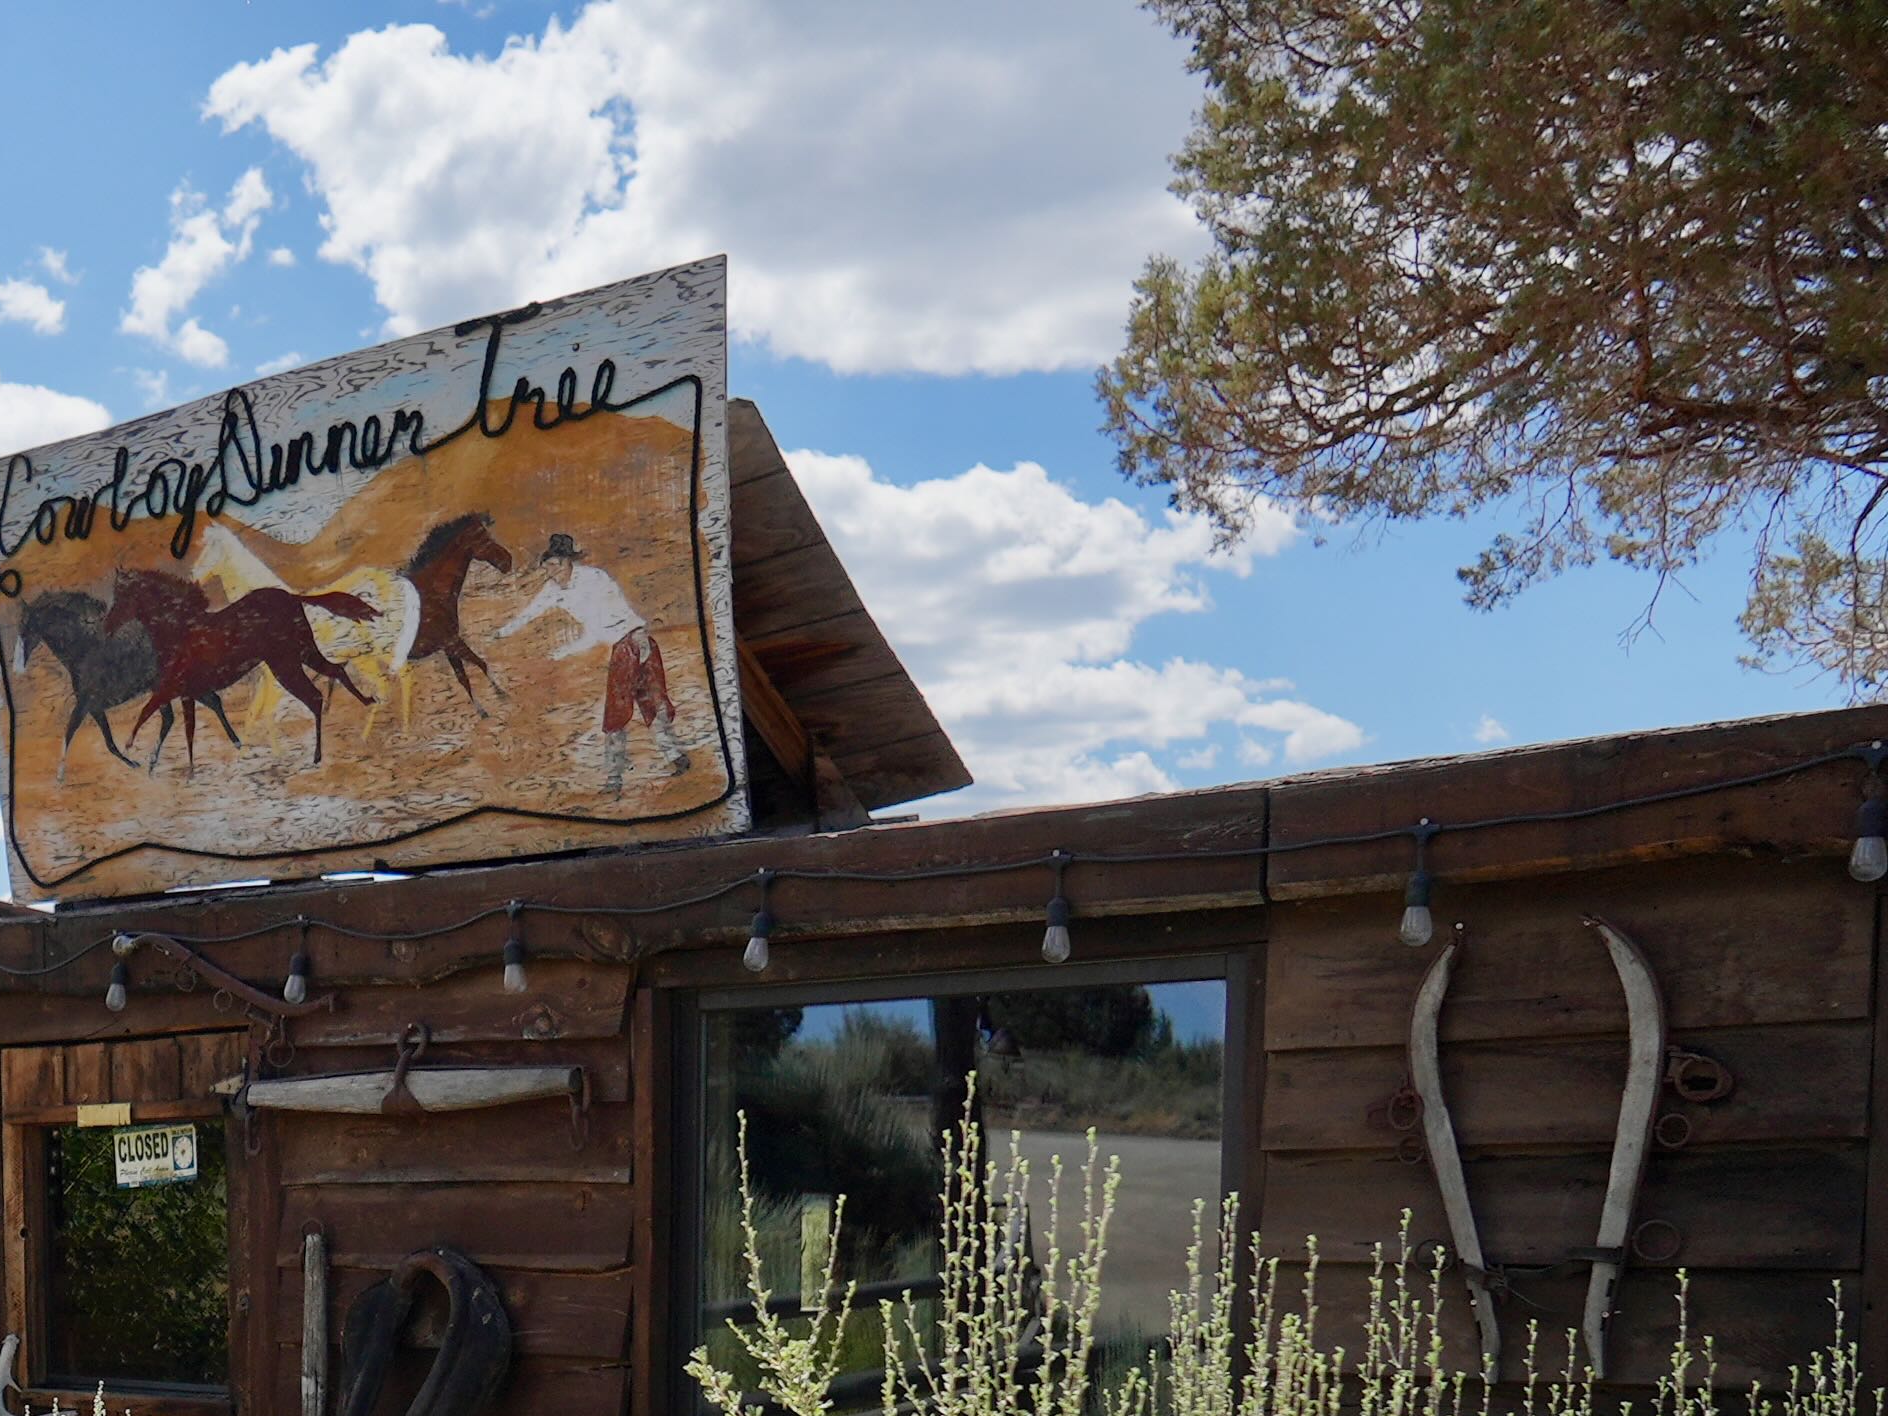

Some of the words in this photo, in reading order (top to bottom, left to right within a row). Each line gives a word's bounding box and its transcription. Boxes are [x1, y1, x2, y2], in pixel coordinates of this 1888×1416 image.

[206, 387, 426, 518] Dinner
[454, 301, 620, 438] Tree
[118, 1132, 169, 1163] CLOSED
